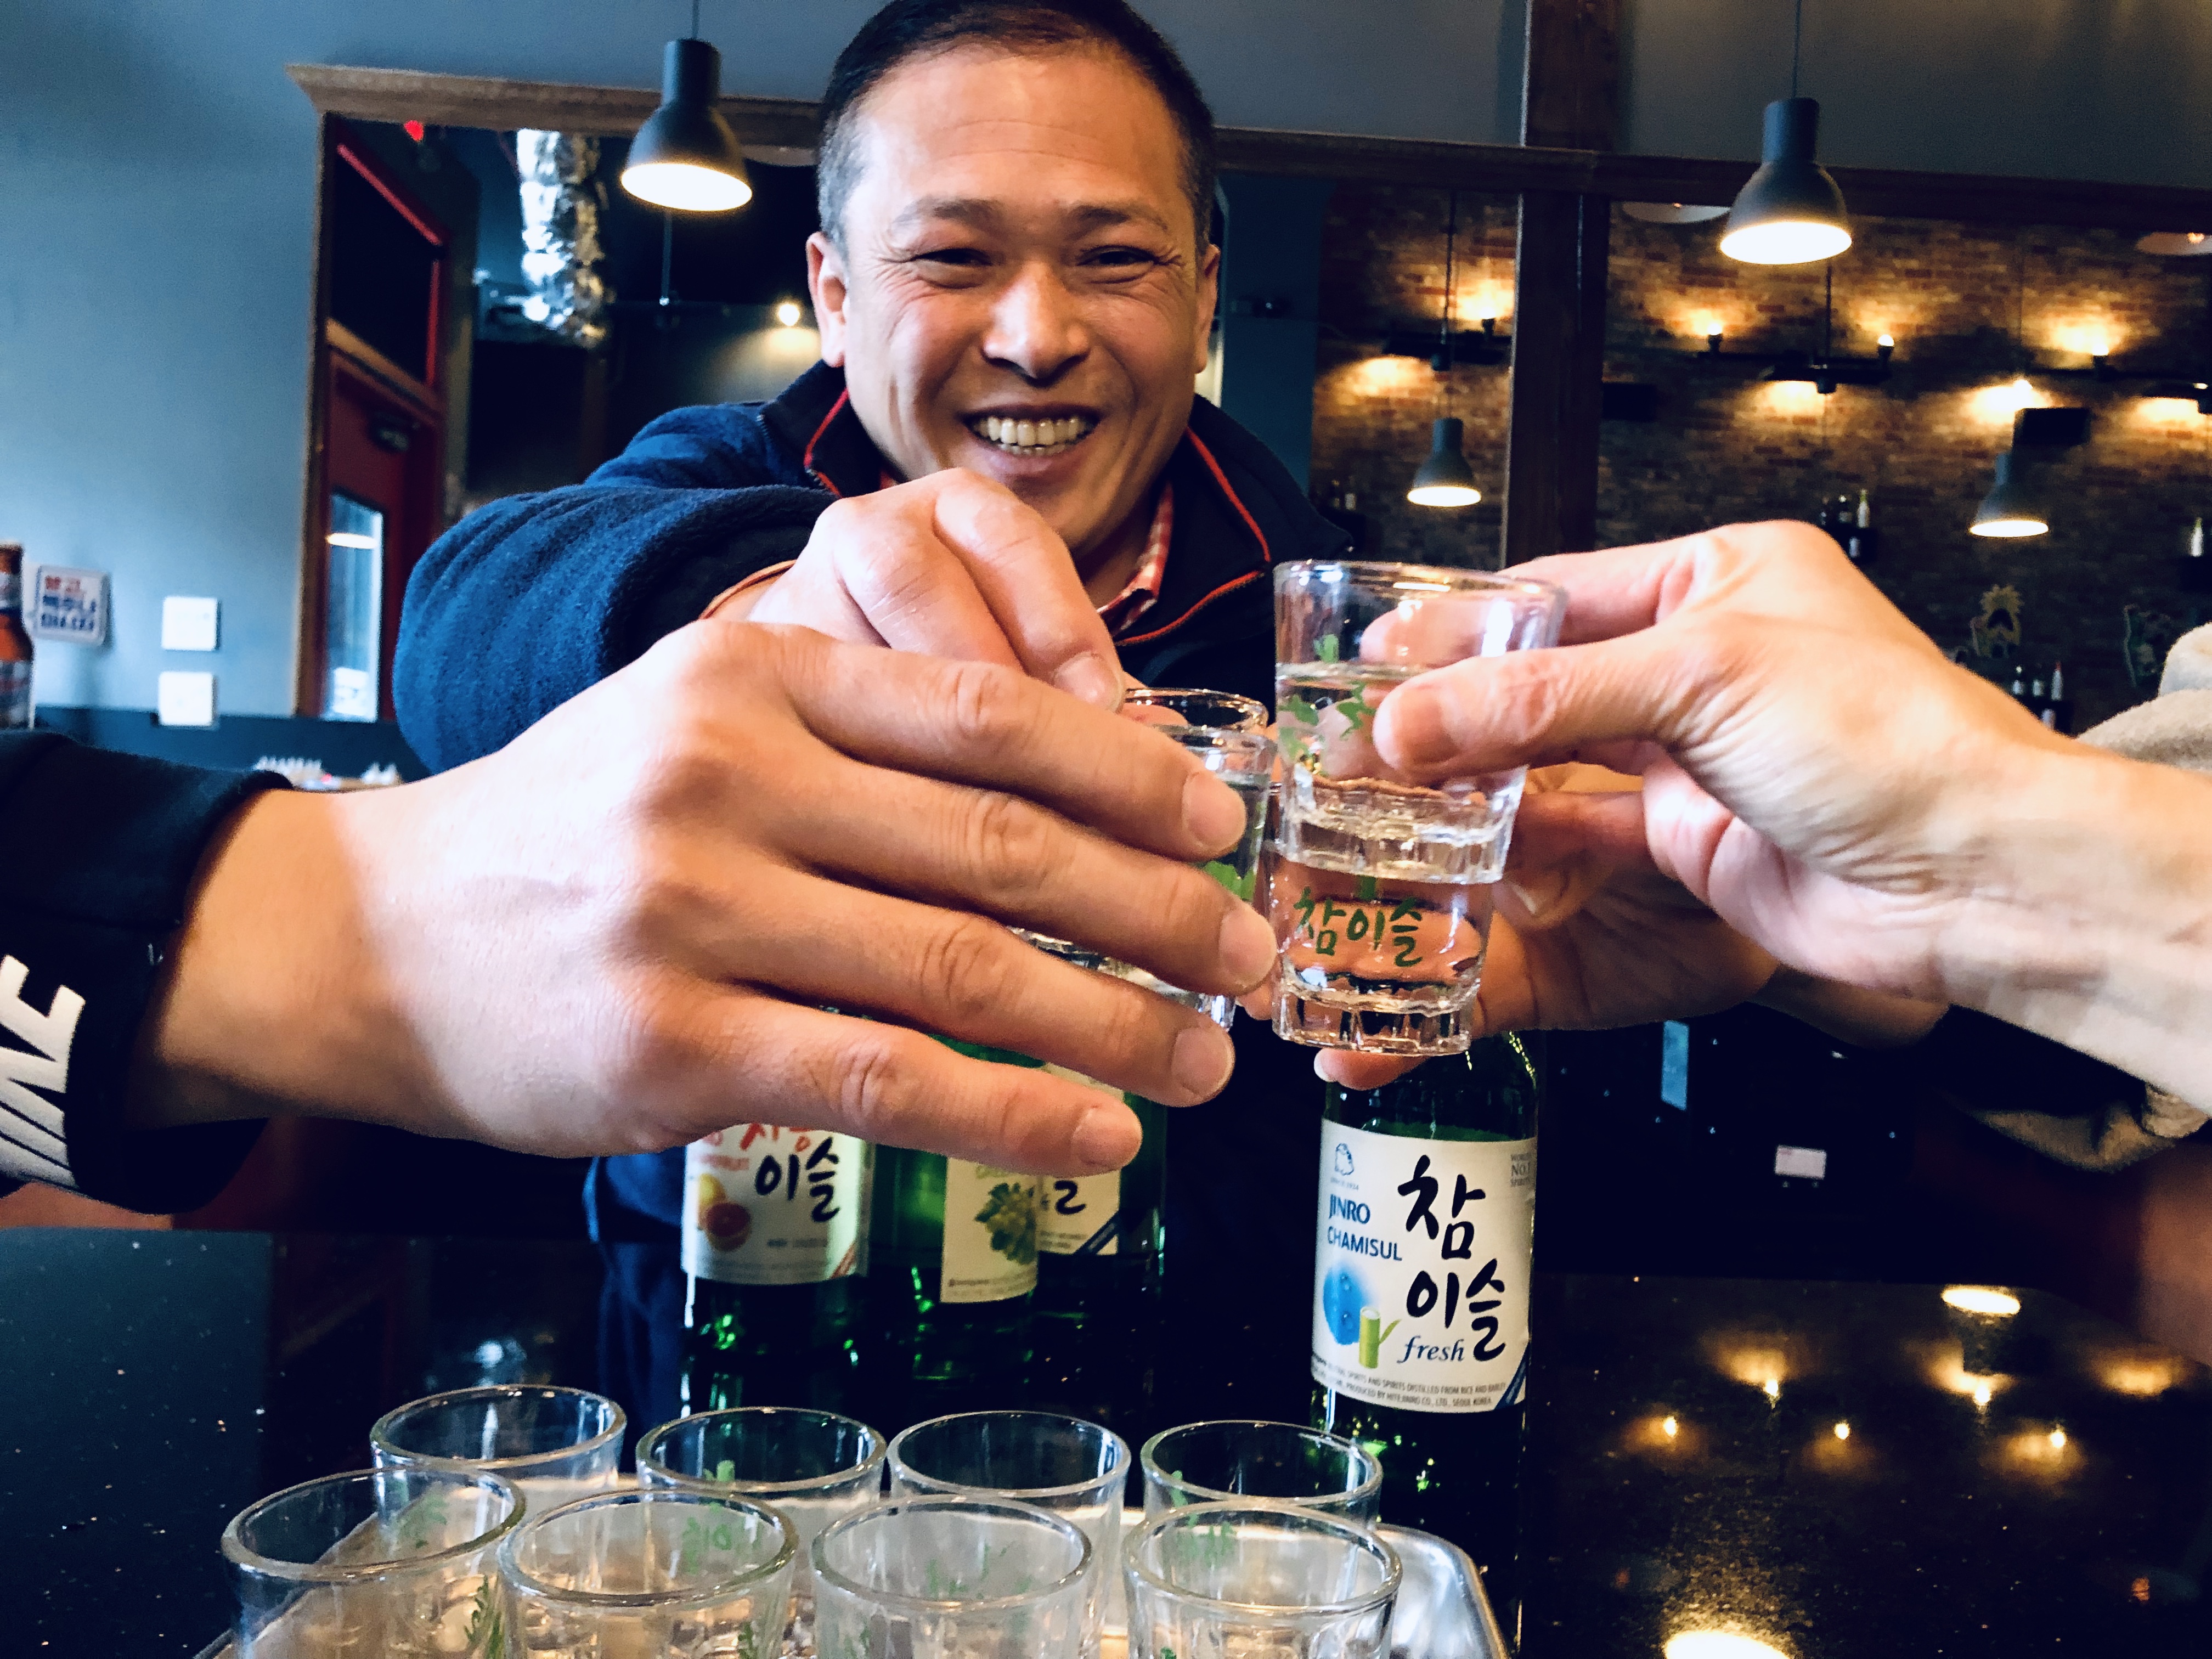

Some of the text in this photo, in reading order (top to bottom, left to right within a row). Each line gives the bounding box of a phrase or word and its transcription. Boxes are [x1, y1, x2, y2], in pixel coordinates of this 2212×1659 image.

[1293, 886, 1423, 967] 참이슬
[755, 1136, 840, 1223] 이슬
[1329, 1193, 1371, 1224] JINRO
[1327, 1226, 1402, 1261] CHAMISUL
[1406, 1259, 1506, 1362] 이슬
[1397, 1335, 1465, 1364] fresh
